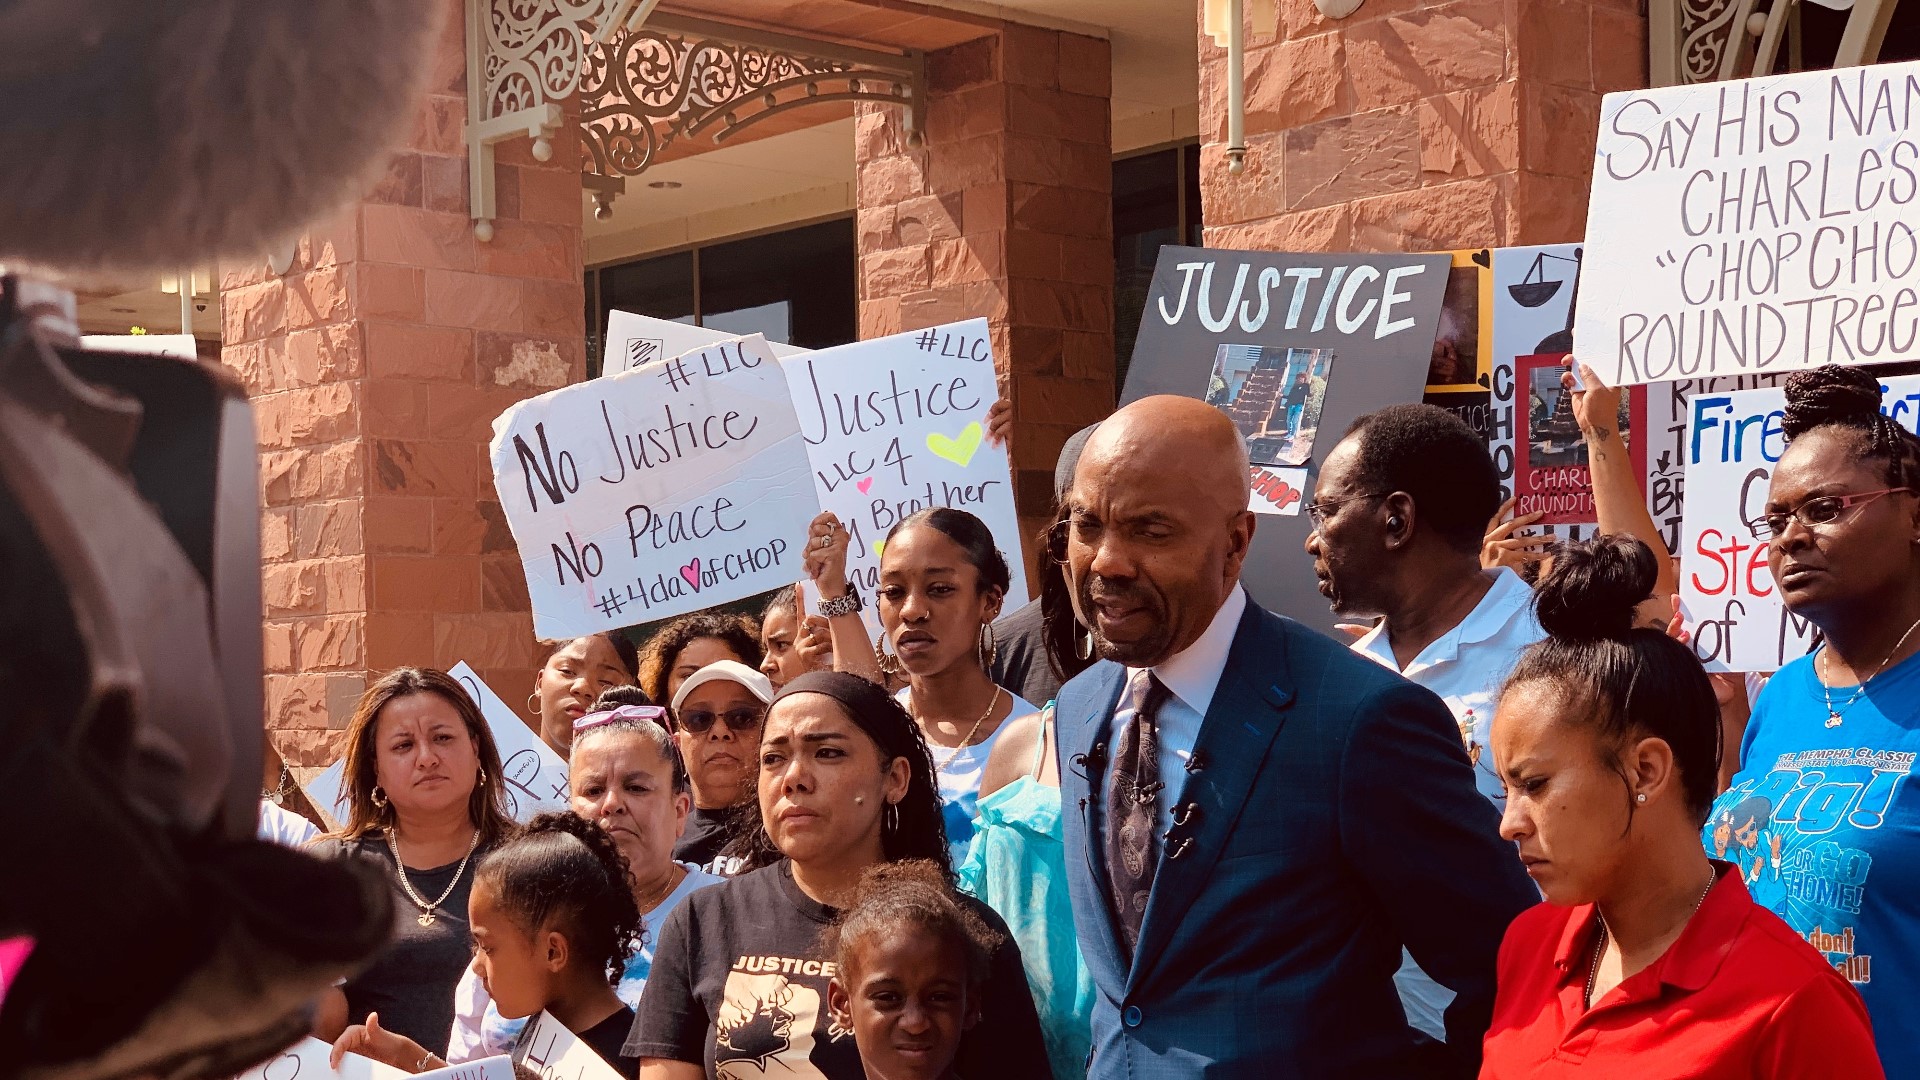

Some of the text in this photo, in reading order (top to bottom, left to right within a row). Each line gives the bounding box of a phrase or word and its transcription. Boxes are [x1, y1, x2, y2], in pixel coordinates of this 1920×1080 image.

[1713, 81, 1801, 158] HIS
[1157, 260, 1426, 340] JUSTICE
[914, 327, 989, 363] #LLC
[802, 360, 981, 446] Justice
[1445, 402, 1490, 433] TICE
[1690, 396, 1785, 465] Fire
[512, 399, 759, 514] No Justice
[817, 436, 913, 494] LLC 4
[1529, 467, 1593, 491] CHARL
[1519, 491, 1597, 515] ROUNDTR
[550, 496, 748, 586] No Peace
[1691, 528, 1773, 598] Ste
[1693, 599, 1746, 664] of
[1796, 747, 1855, 761] MEMPHIS
[1855, 746, 1917, 764] CLASSIC
[1787, 869, 1865, 915] HOME!
[1793, 840, 1873, 887] OR GO
[732, 955, 839, 978] JUSTICE
